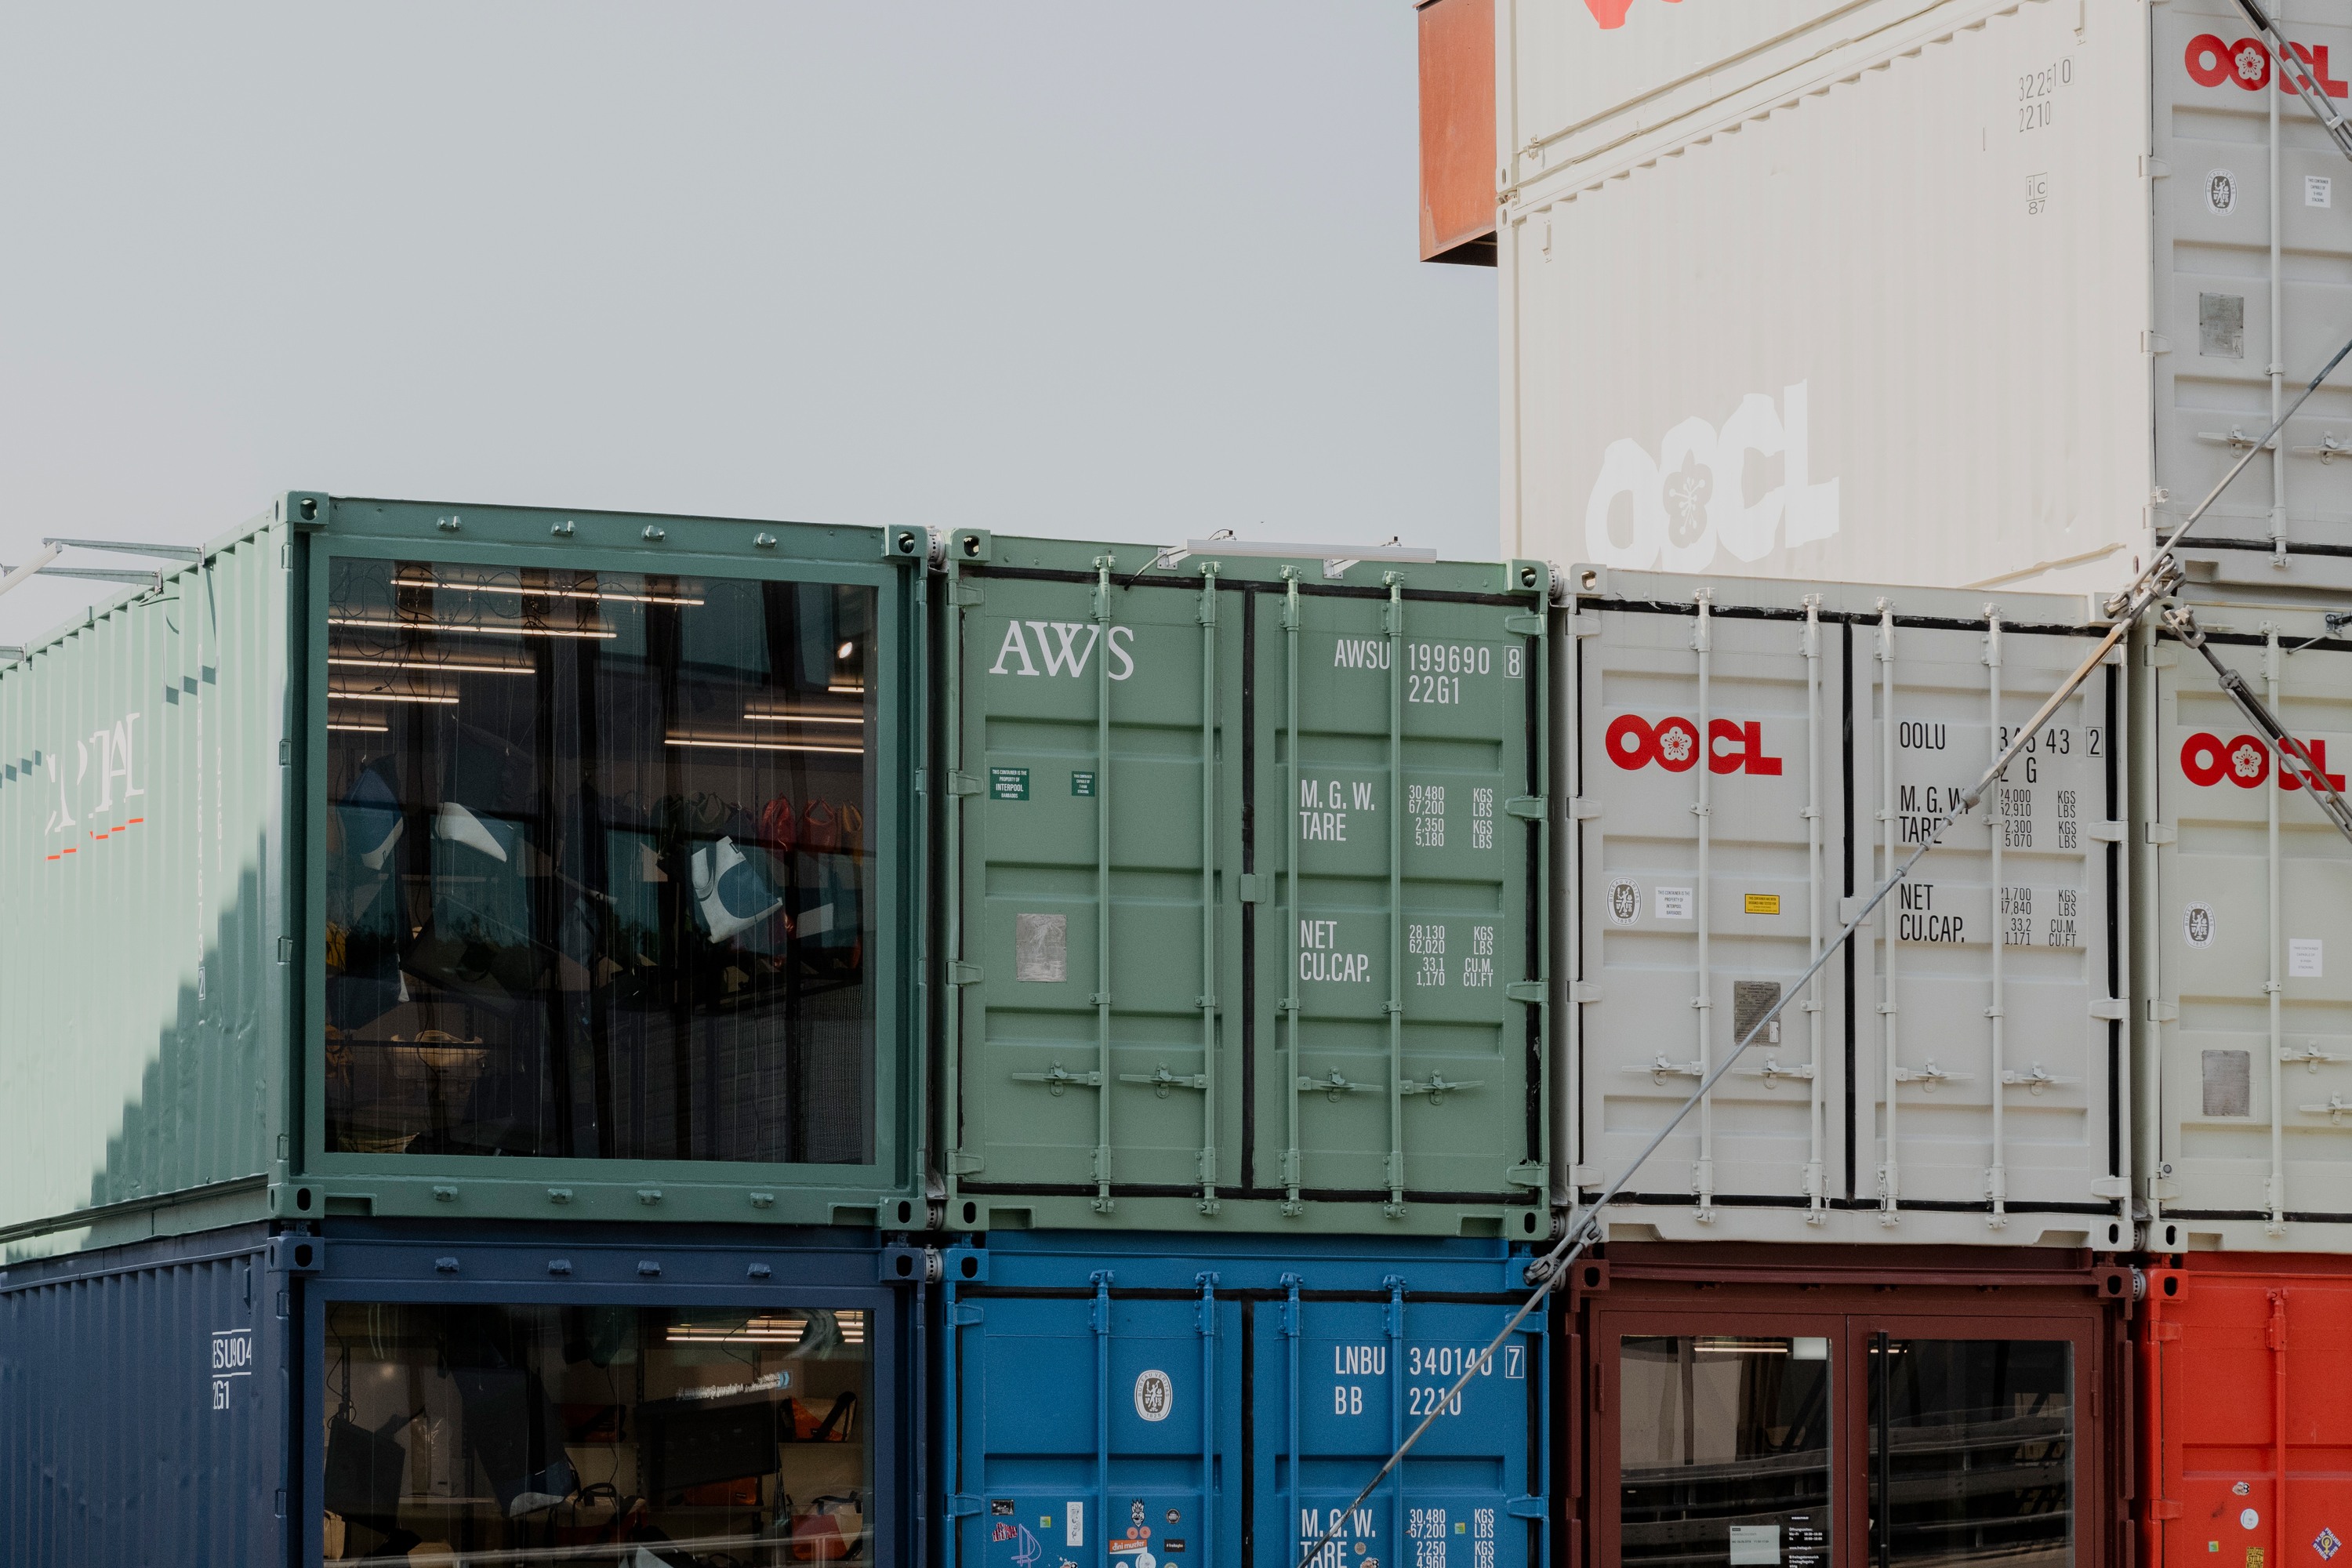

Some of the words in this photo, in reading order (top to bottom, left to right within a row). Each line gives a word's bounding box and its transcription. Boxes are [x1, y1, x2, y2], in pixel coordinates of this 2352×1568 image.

[2184, 34, 2348, 99] OOCL
[2019, 100, 2051, 133] 2210
[2028, 200, 2046, 216] 87
[1585, 378, 1840, 573] OOCL
[989, 620, 1134, 681] AWS
[1334, 639, 1391, 670] AWSU
[1408, 643, 1490, 676] 199690
[1506, 648, 1521, 677] 8
[1408, 675, 1460, 706] 22G1
[1605, 713, 1784, 776] OOCL
[1900, 721, 1946, 750] OOLU
[2089, 729, 2100, 756] 2
[2026, 757, 2037, 784] G
[2180, 731, 2346, 793] OOCL
[996, 783, 1024, 792] INTERPOOL
[1301, 779, 1323, 809] M.
[1329, 781, 1347, 810] G.
[1352, 782, 1375, 811] W.
[1409, 785, 1444, 801] 30,480
[1473, 788, 1493, 804] KGS
[1900, 785, 1920, 812] M.
[1926, 786, 1943, 814] G.
[2057, 790, 2076, 805] KGS
[1409, 800, 1444, 815] 67,200
[1473, 802, 1492, 818] LBS
[2057, 804, 2076, 818] LBS
[1300, 811, 1347, 842] TARE
[1415, 817, 1444, 833] 2,350
[1473, 819, 1493, 835] KGS
[1899, 816, 1943, 844] TARE
[2005, 820, 2032, 835] 2,300
[2058, 822, 2077, 836] KGS
[1415, 831, 1444, 848] 5,180
[1473, 834, 1492, 849] LBS
[2059, 835, 2077, 849] LBS
[1609, 879, 1624, 903] BUREAU
[1624, 879, 1640, 904] VERITAS
[1900, 883, 1934, 911] NET
[2058, 889, 2077, 903] KGS
[2058, 903, 2077, 916] LBS
[1301, 920, 1338, 950] NET
[1409, 925, 1445, 941] 28,130
[1473, 927, 1493, 942] KGS
[1900, 914, 1965, 943] CU.CAP.
[2050, 919, 2077, 934] CU.M.
[1409, 939, 1445, 955] 62,020
[1473, 941, 1493, 956] LBS
[2004, 931, 2031, 946] 1,171
[2049, 933, 2077, 948] CU.FT
[1300, 952, 1370, 982] CU.CAP.
[1465, 958, 1494, 974] CU.M.
[1417, 971, 1445, 987] 1,170
[1463, 972, 1494, 987] CU.FT
[1335, 1346, 1386, 1375] LNBU
[1409, 1347, 1493, 1376] 340140
[1508, 1348, 1522, 1377] 7
[1137, 1373, 1152, 1397] BUREAU
[1154, 1373, 1170, 1397] VERITAS
[1335, 1386, 1363, 1415] BB
[1409, 1387, 1461, 1416] 2210
[1301, 1508, 1323, 1537] M.
[1352, 1508, 1376, 1538] W.
[1410, 1508, 1446, 1525] 30,480
[1474, 1508, 1494, 1523] KGS
[1410, 1523, 1446, 1539] 67,200
[1474, 1523, 1494, 1538] LBS
[2325, 1526, 2343, 1548] FRAUEN
[1300, 1541, 1348, 1568] TARE
[1416, 1541, 1446, 1556] 2,250
[1474, 1541, 1494, 1556] KGS
[2312, 1543, 2328, 1561] STREIK
[1474, 1555, 1494, 1568] LBS
